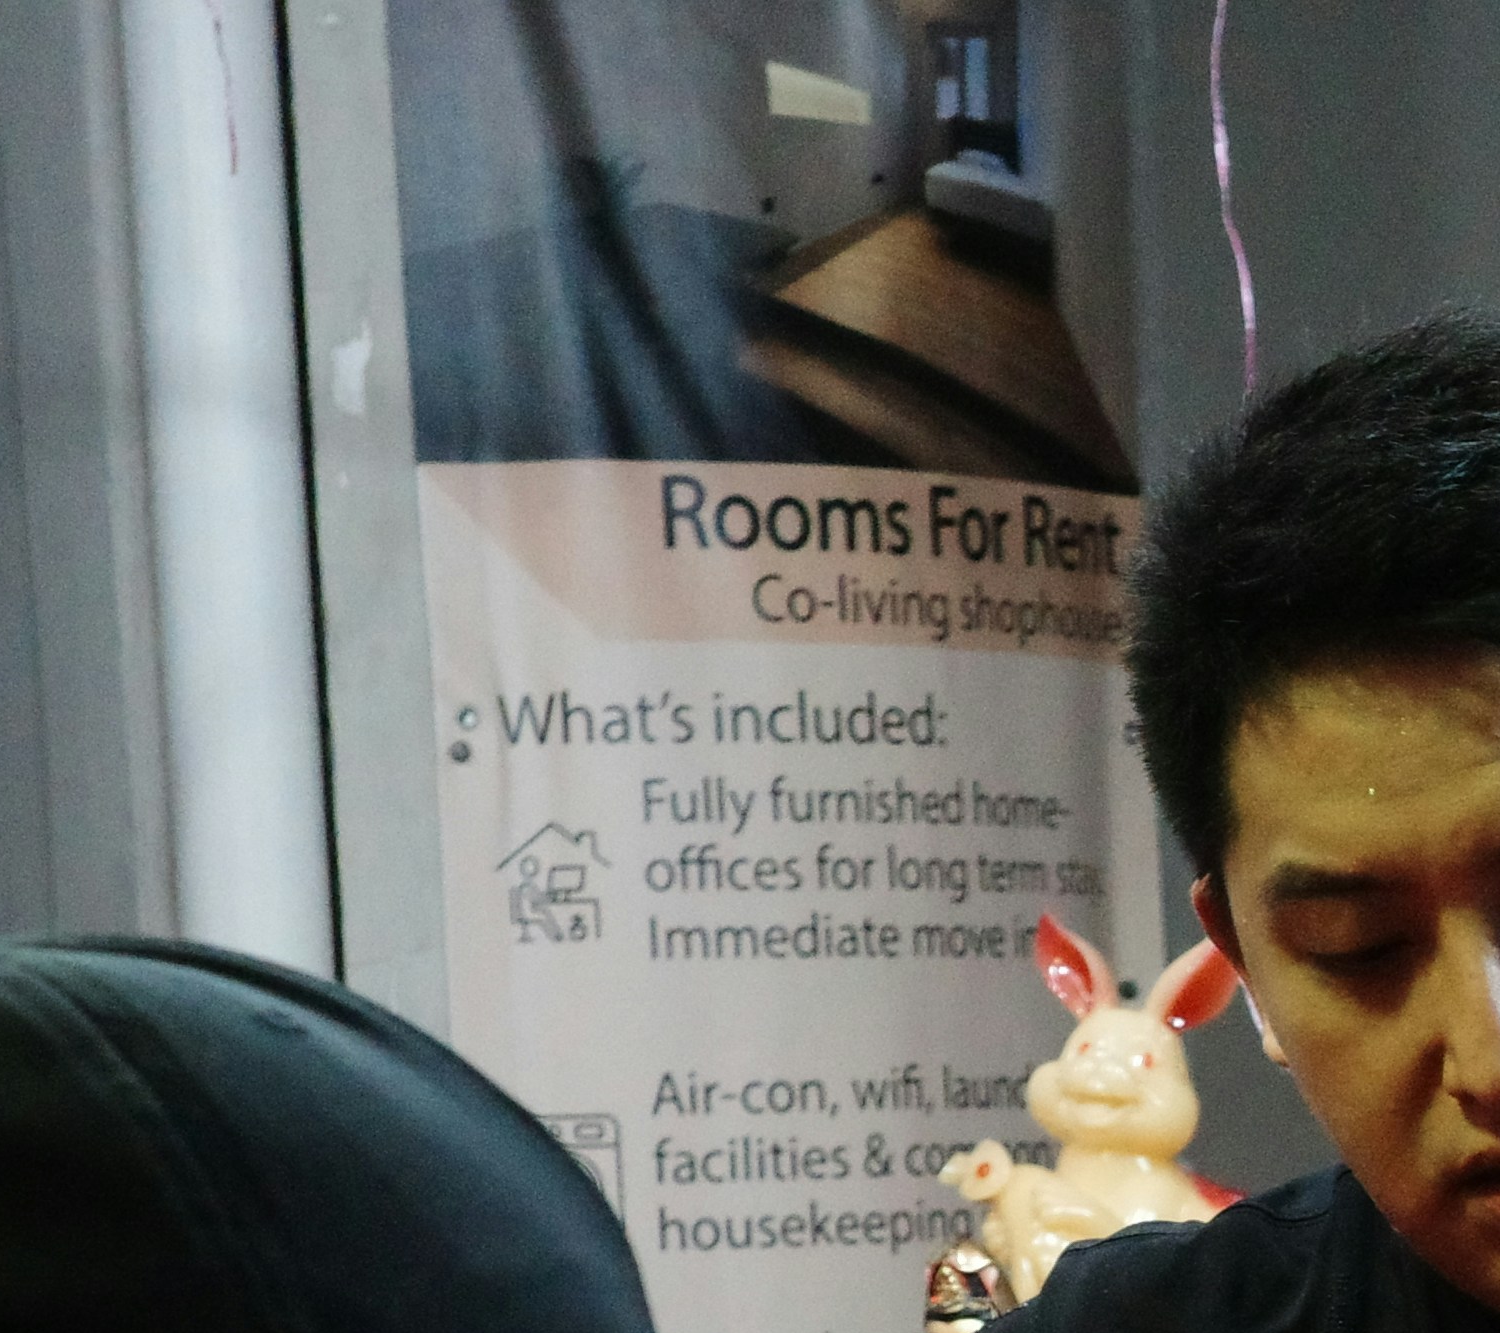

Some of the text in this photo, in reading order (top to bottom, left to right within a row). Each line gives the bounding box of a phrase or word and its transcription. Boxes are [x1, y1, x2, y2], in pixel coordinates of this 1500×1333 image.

[661, 474, 1122, 573] Rooms For Rent
[752, 573, 951, 642] Co-living
[497, 688, 948, 745] What's included:
[642, 775, 1070, 834] Fully furnished home-
[644, 842, 801, 892] offices
[815, 842, 875, 891] for
[886, 844, 968, 902] long
[977, 855, 1046, 893] term
[649, 910, 900, 960] Immediate
[912, 921, 1005, 959] move
[651, 1071, 839, 1118] Air-con,
[852, 1063, 933, 1114] wifi,
[654, 1137, 851, 1186] facilities
[863, 1133, 893, 1179] &
